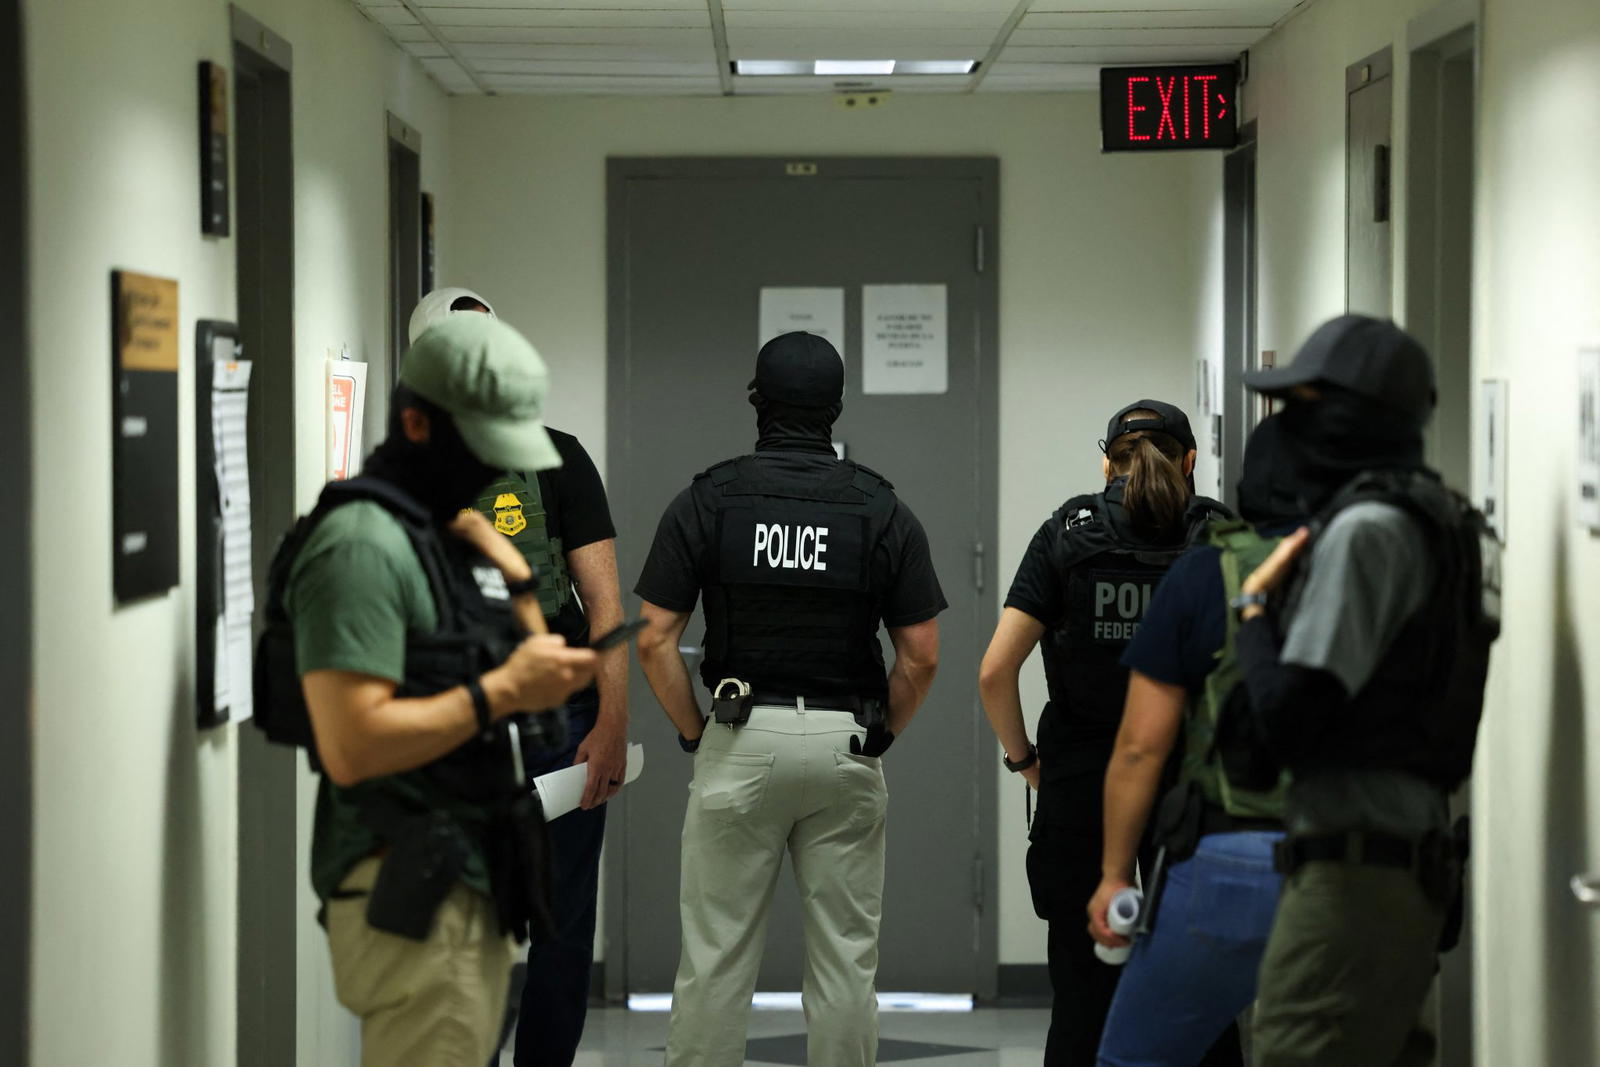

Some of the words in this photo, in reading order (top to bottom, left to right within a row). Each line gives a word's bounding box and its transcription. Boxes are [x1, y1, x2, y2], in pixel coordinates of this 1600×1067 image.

[1128, 76, 1218, 140] EXIT
[753, 523, 829, 571] POLICE
[1095, 582, 1151, 619] POL
[1094, 621, 1141, 640] FEDE
